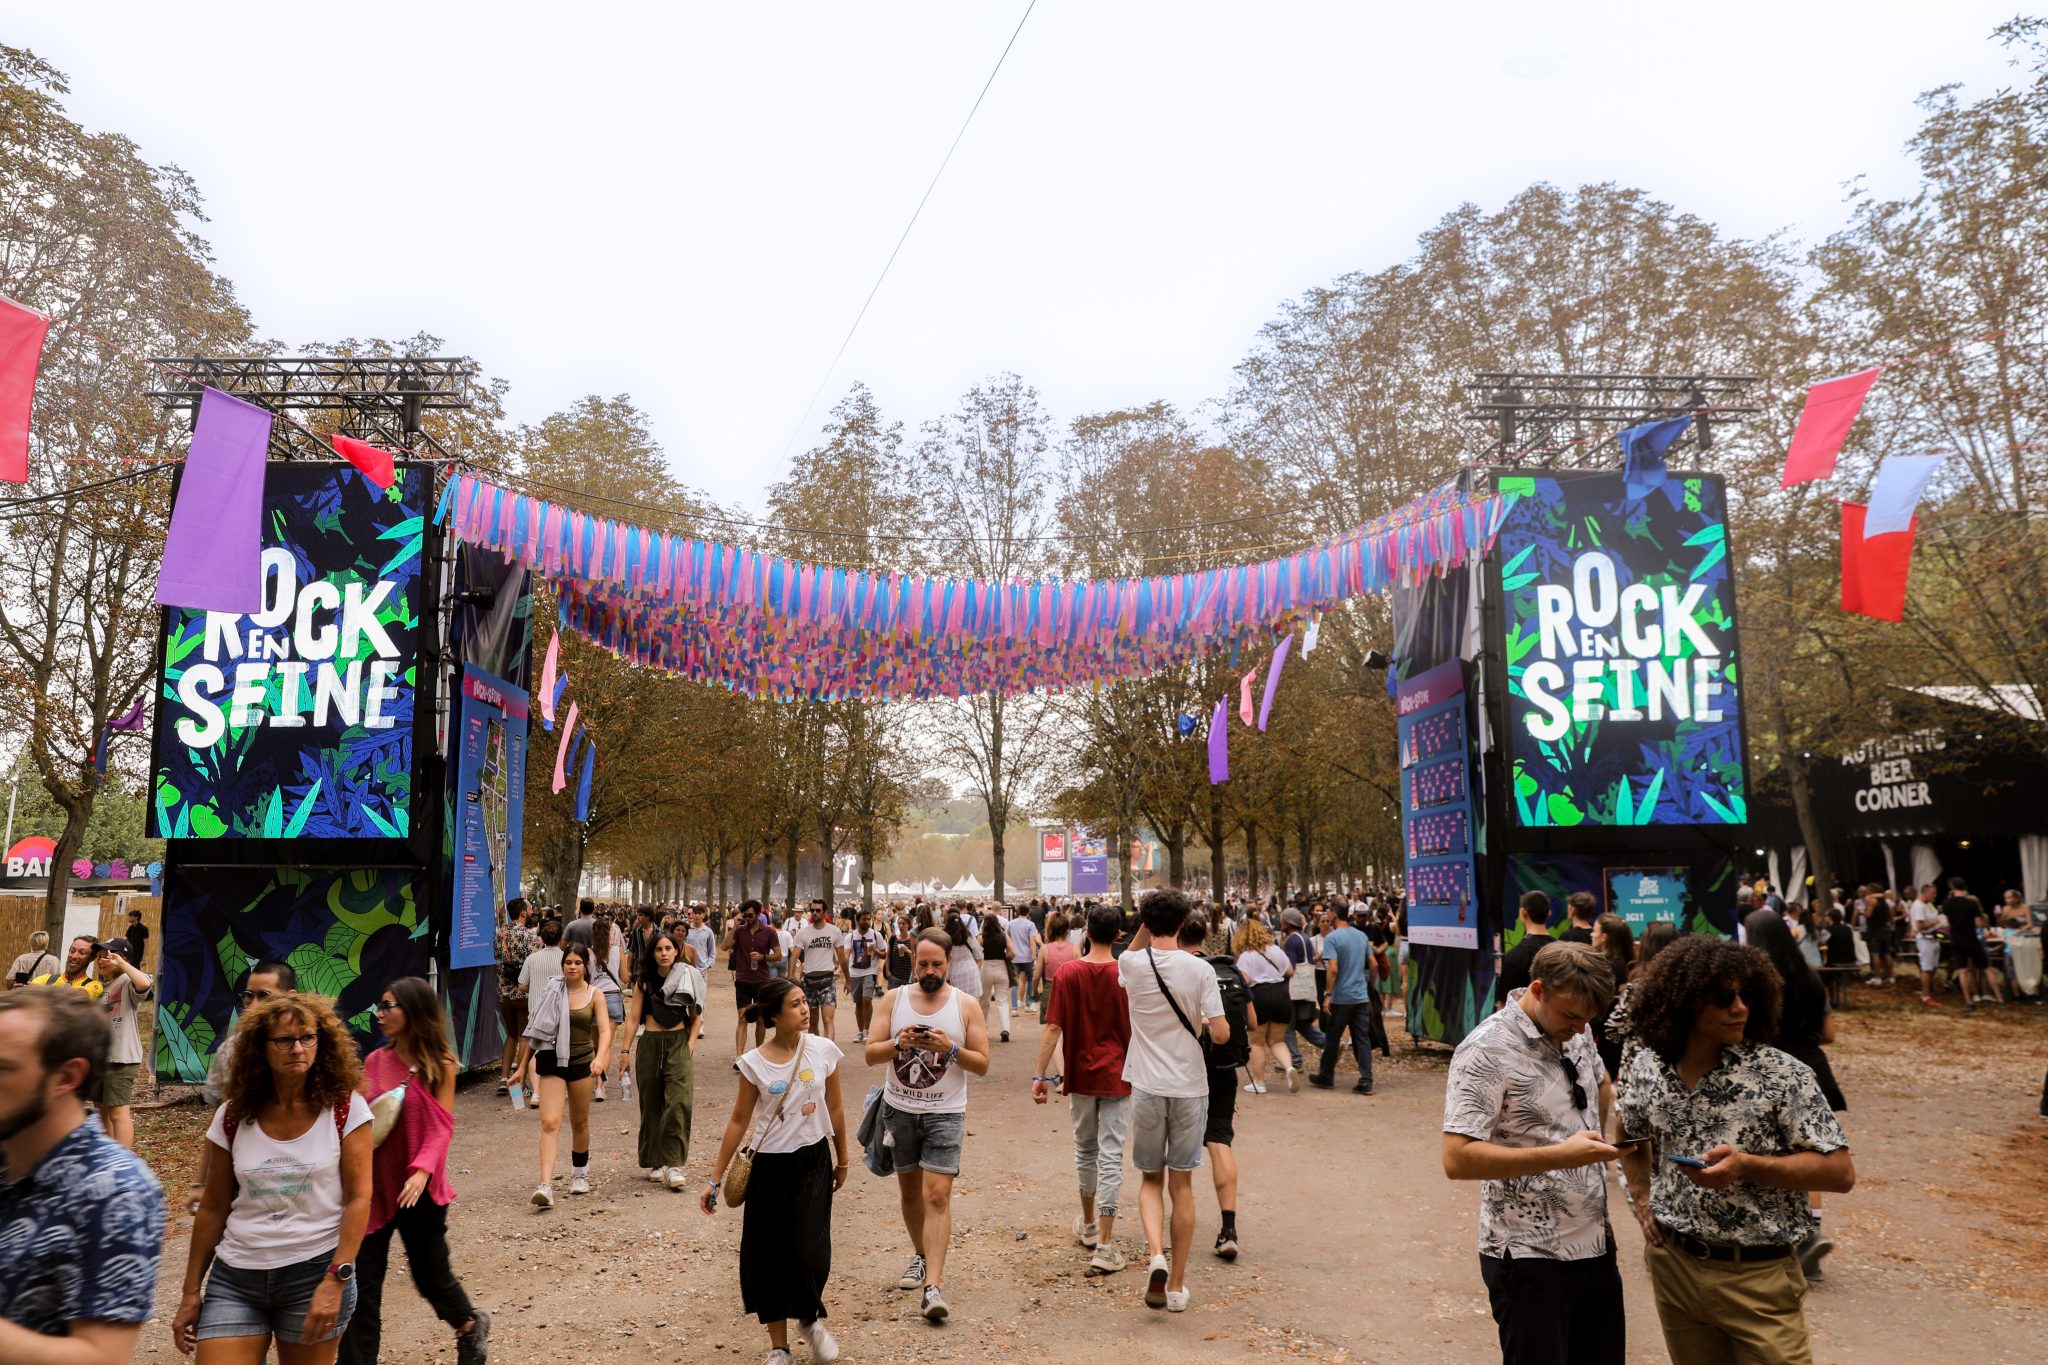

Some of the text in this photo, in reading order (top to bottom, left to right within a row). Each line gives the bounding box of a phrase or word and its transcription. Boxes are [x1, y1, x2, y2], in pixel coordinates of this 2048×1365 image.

[203, 547, 401, 662] ROCK
[1537, 551, 1721, 660] ROCK
[247, 629, 290, 660] EN
[1580, 628, 1620, 658] EN
[177, 660, 401, 749] SEINE
[1521, 658, 1724, 741] SEINE
[1870, 758, 1914, 785] BEER
[1855, 782, 1932, 812] CORNER
[1045, 848, 1063, 858] inter
[811, 936, 831, 944] ARCTIC
[903, 1088, 922, 1098] WILD
